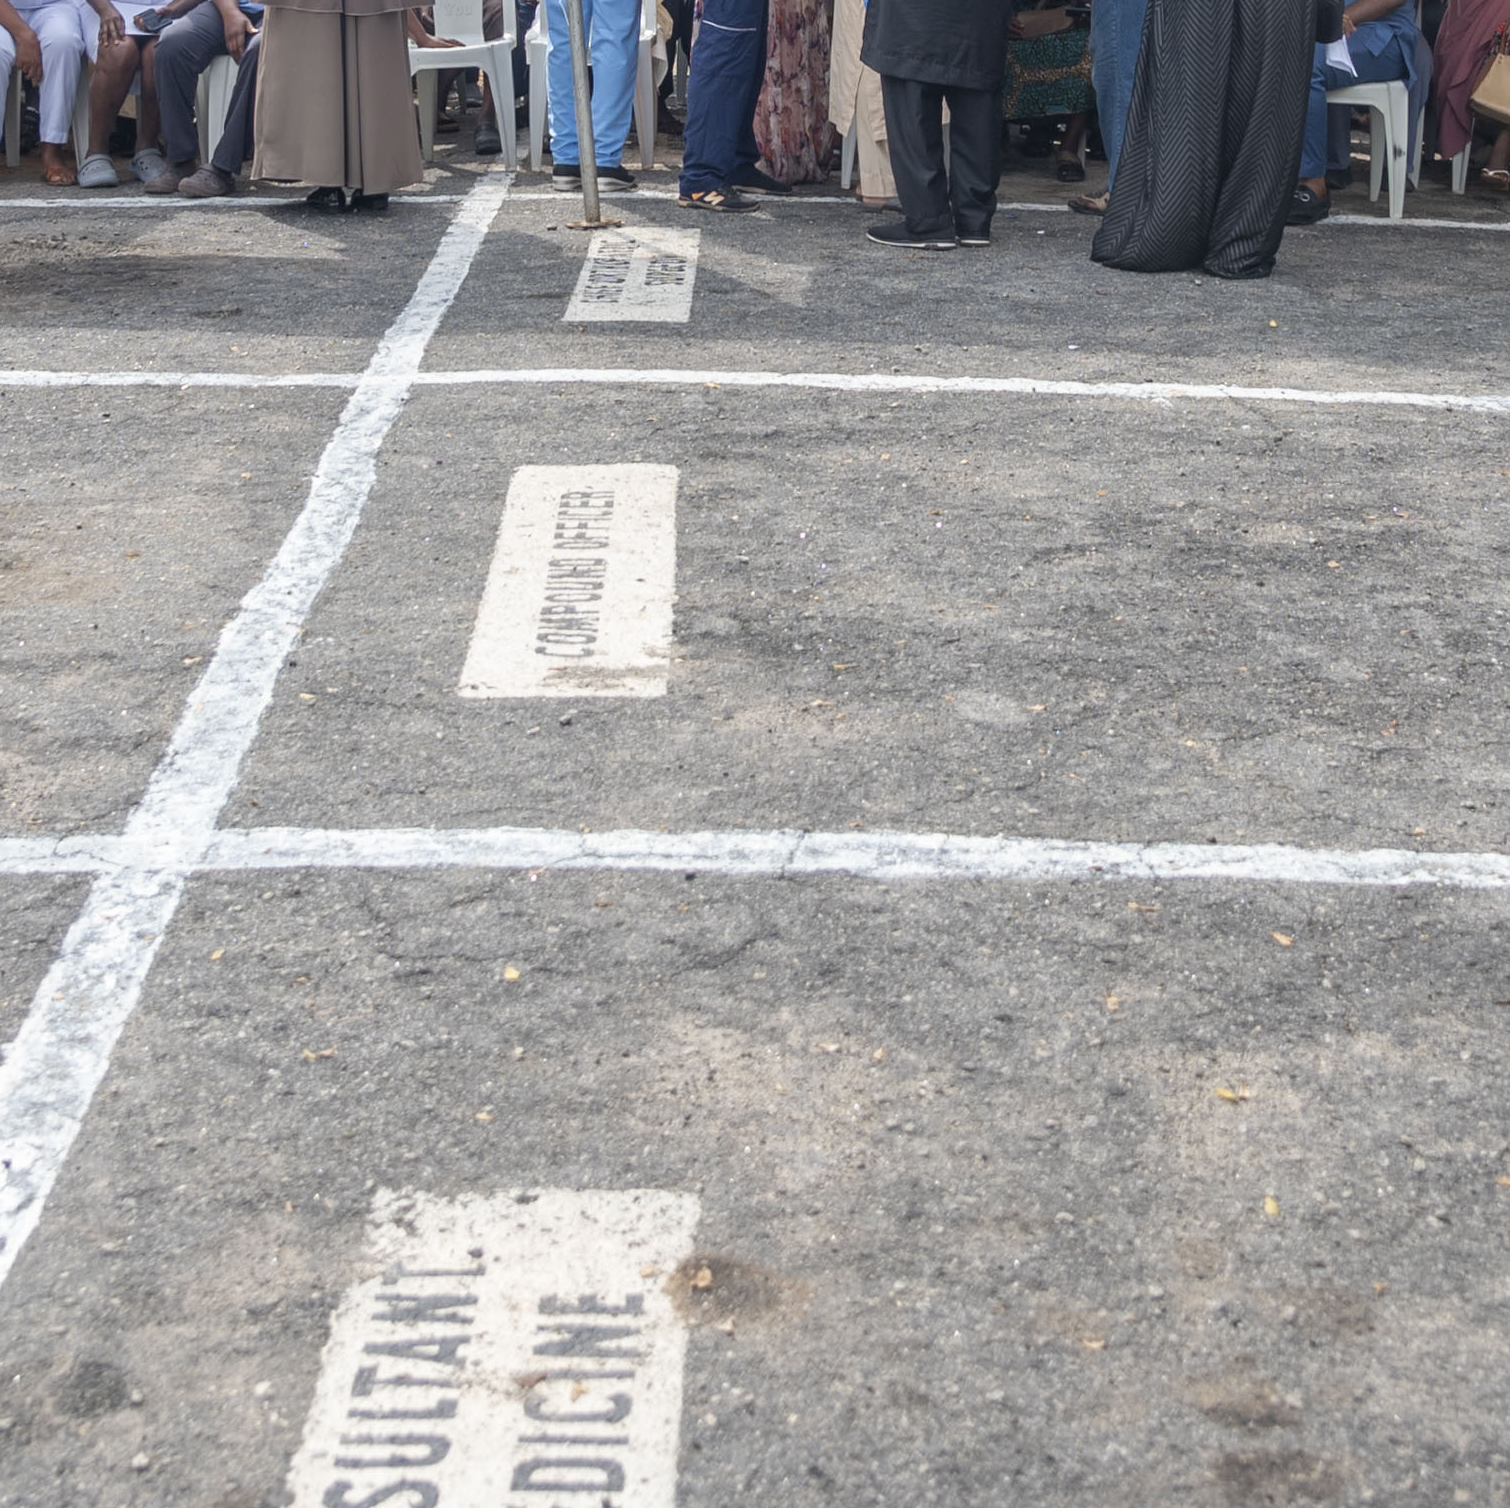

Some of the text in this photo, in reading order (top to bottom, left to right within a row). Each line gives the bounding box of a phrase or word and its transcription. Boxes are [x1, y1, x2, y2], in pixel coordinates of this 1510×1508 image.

[534, 491, 615, 658] COMPOUND OFFICER
[507, 1293, 644, 1508] DICINE
